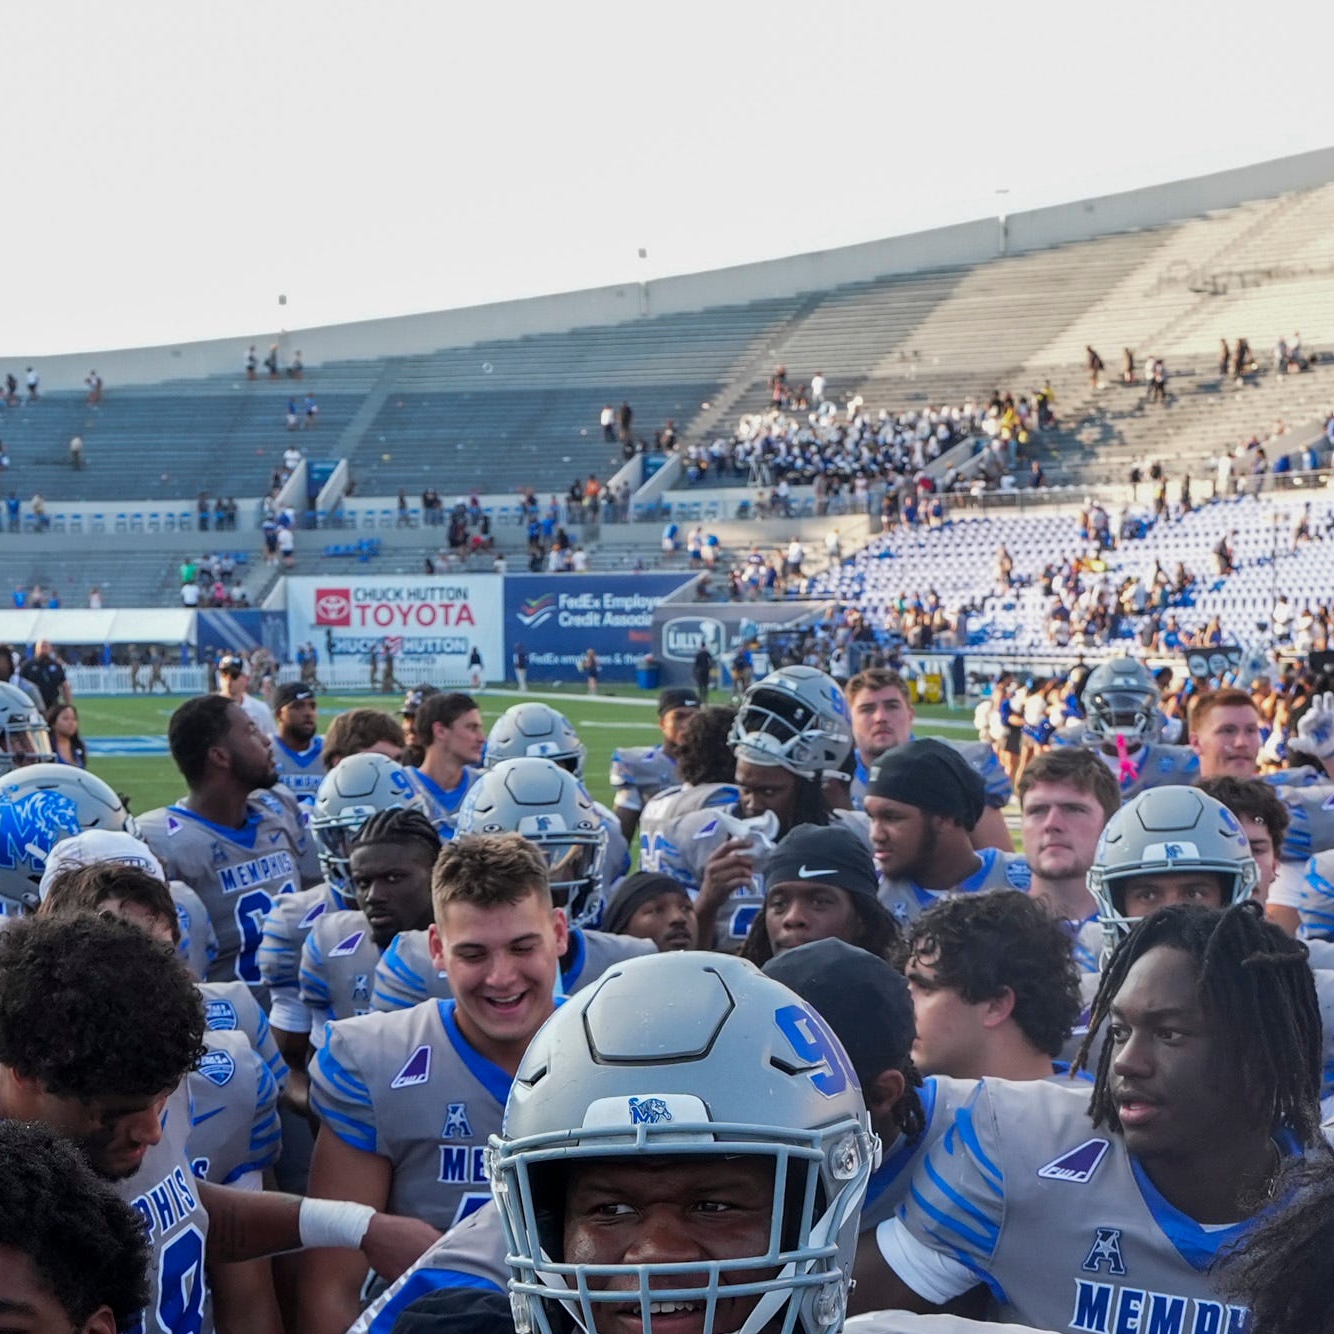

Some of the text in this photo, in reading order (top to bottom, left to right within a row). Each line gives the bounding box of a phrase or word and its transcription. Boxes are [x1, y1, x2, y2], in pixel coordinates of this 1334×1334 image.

[353, 586, 469, 602] CHUCK HUTTON
[558, 594, 601, 610] FedEx
[354, 603, 475, 627] TOYOTA
[558, 611, 601, 627] Credit
[403, 638, 468, 654] HUTTON
[218, 850, 294, 894] MEMPHIS
